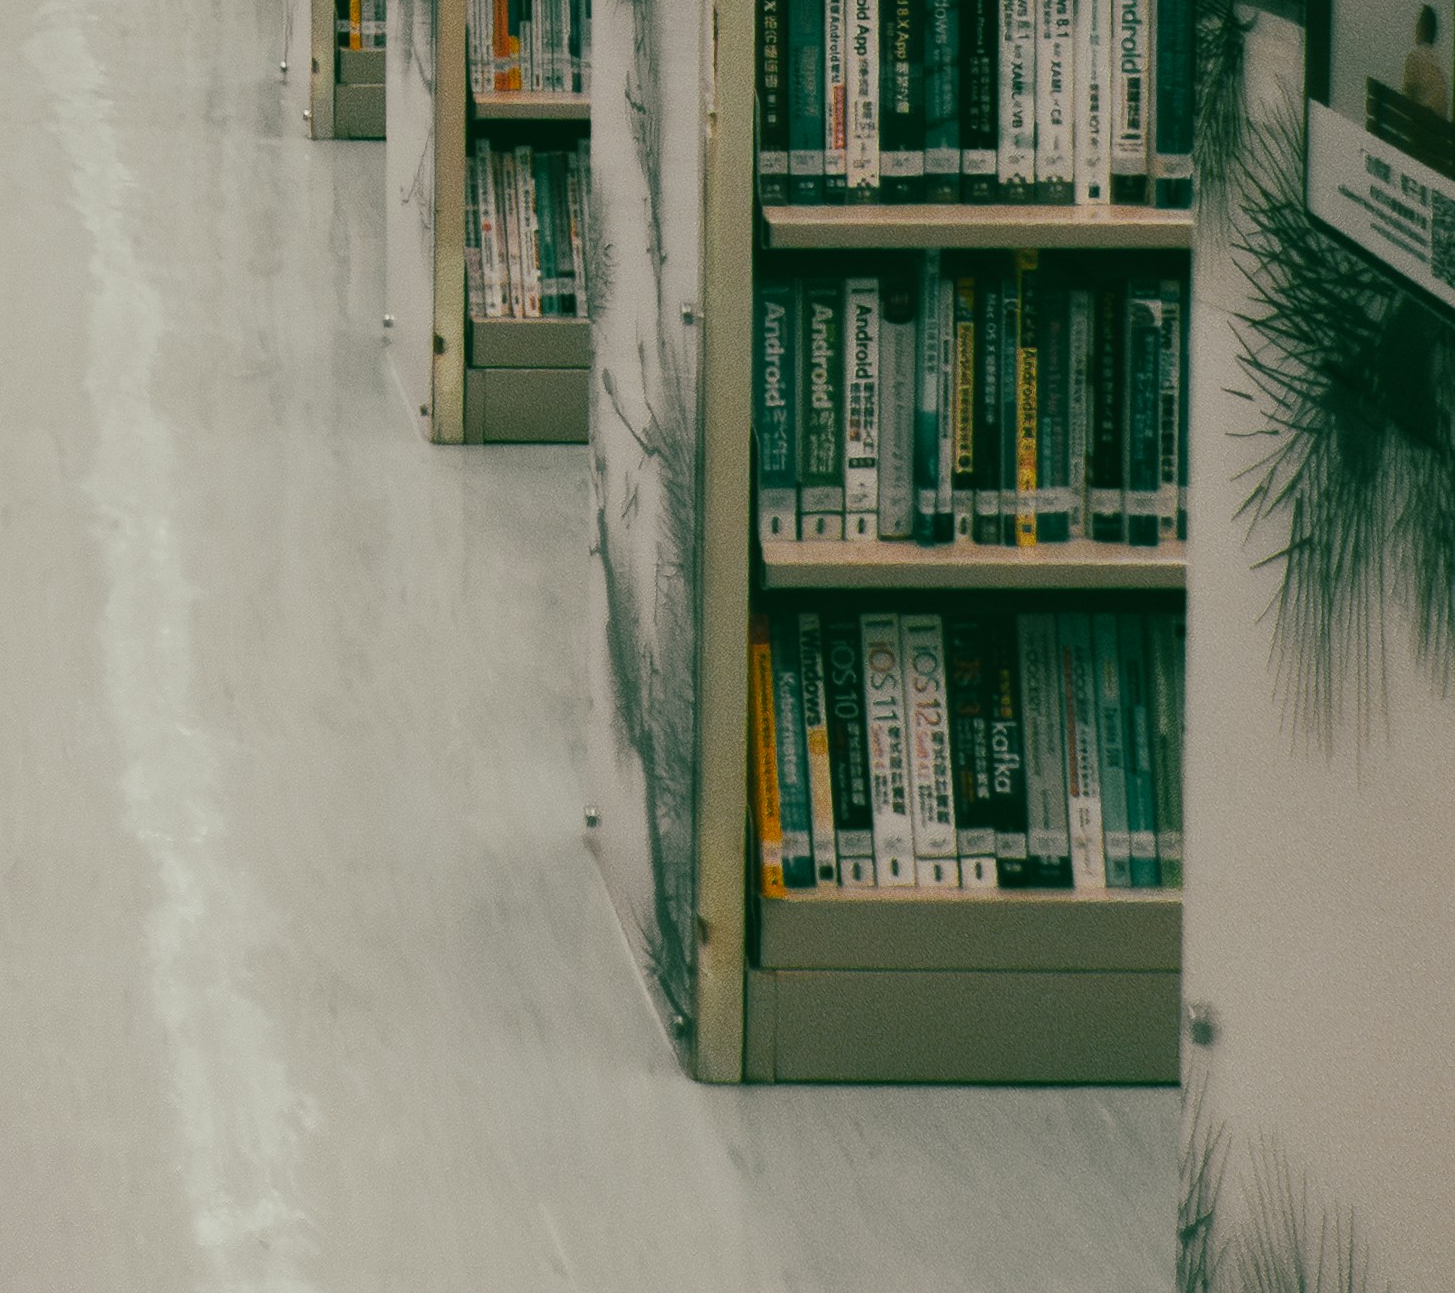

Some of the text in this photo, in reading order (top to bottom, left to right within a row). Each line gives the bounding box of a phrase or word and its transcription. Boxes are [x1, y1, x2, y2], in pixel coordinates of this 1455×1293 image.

[854, 24, 870, 55] App
[895, 31, 908, 60] App
[1057, 18, 1069, 38] 8.1
[764, 302, 786, 407] Android
[810, 303, 834, 409] Android
[855, 305, 871, 379] Android
[801, 629, 823, 727] Windows
[831, 641, 858, 719] iOS 10
[869, 643, 898, 722] iOS 11
[913, 646, 941, 727] iOS 12
[779, 672, 798, 784] Kubernetes
[991, 721, 1020, 793] kafka
